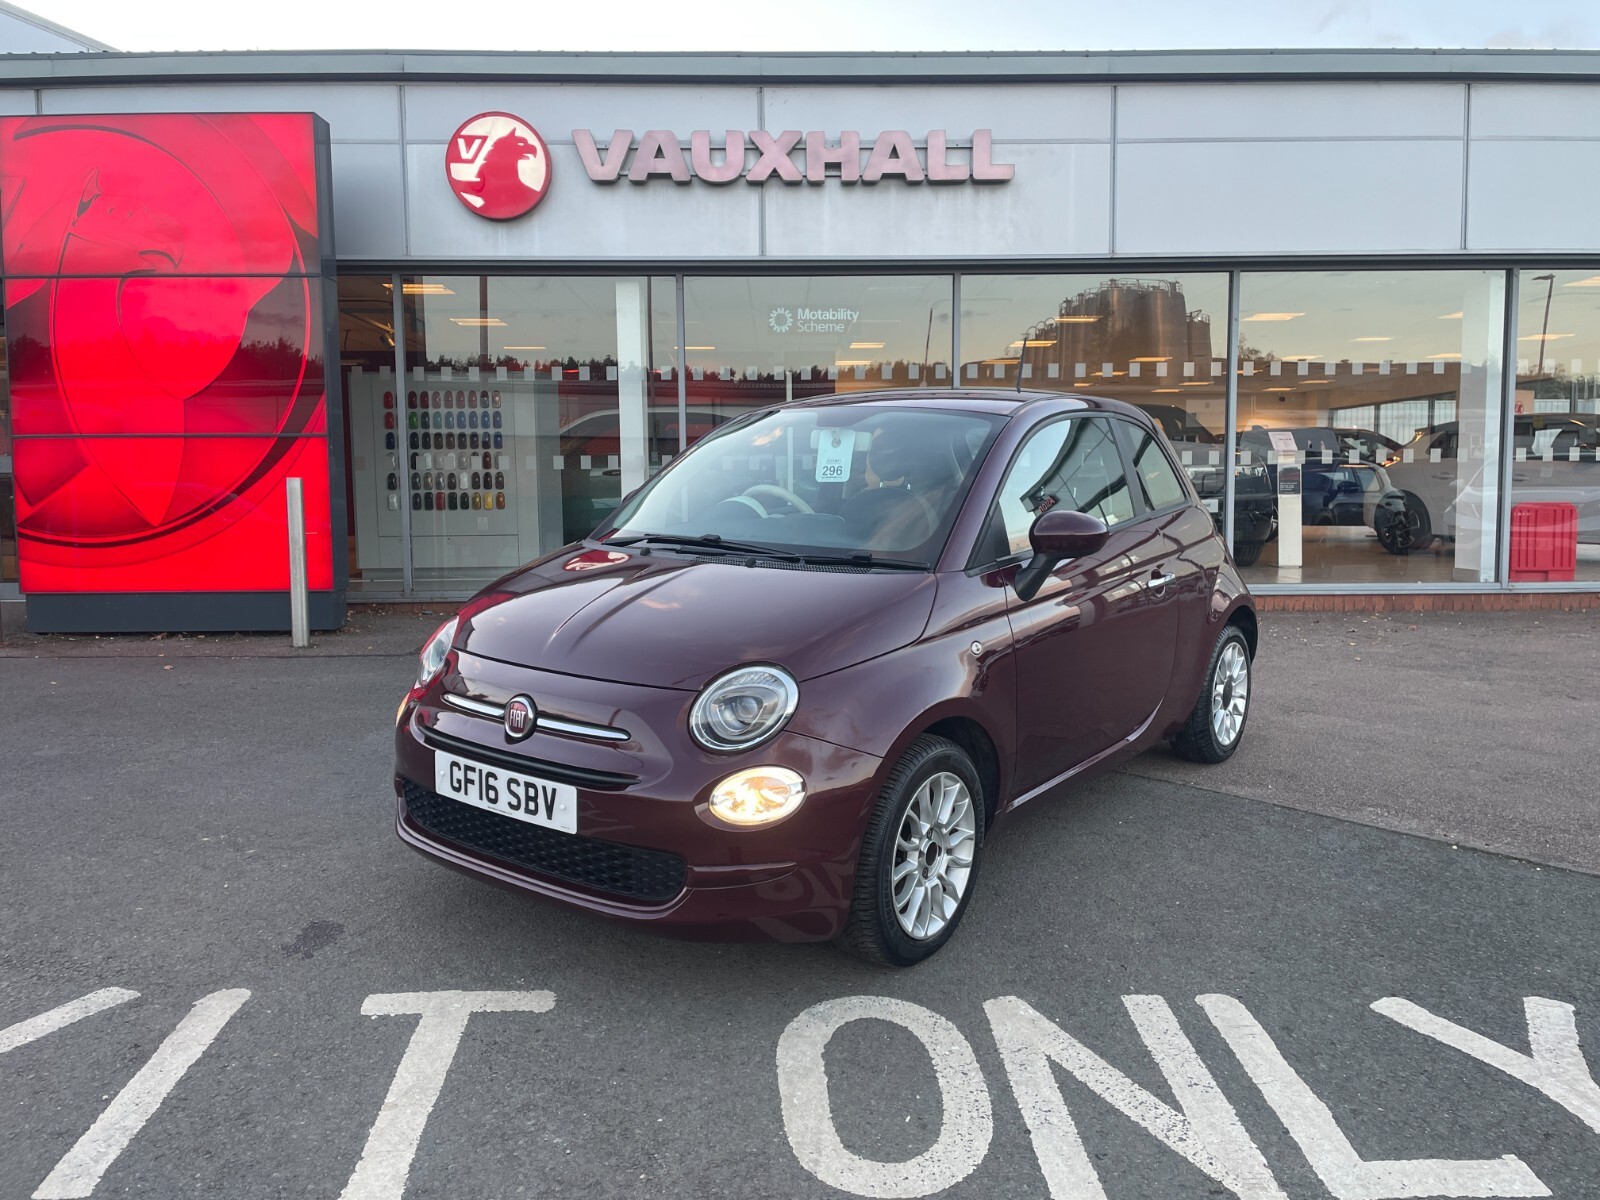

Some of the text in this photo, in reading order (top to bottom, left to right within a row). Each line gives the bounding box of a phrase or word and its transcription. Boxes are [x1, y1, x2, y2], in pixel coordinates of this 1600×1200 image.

[572, 128, 1015, 185] VAUXHALL
[797, 308, 859, 323] Motability
[797, 321, 845, 332] Scheme
[822, 465, 843, 476] 296
[510, 709, 526, 728] FIAT
[449, 760, 557, 821] GF16 SBV
[0, 986, 557, 1200] IT
